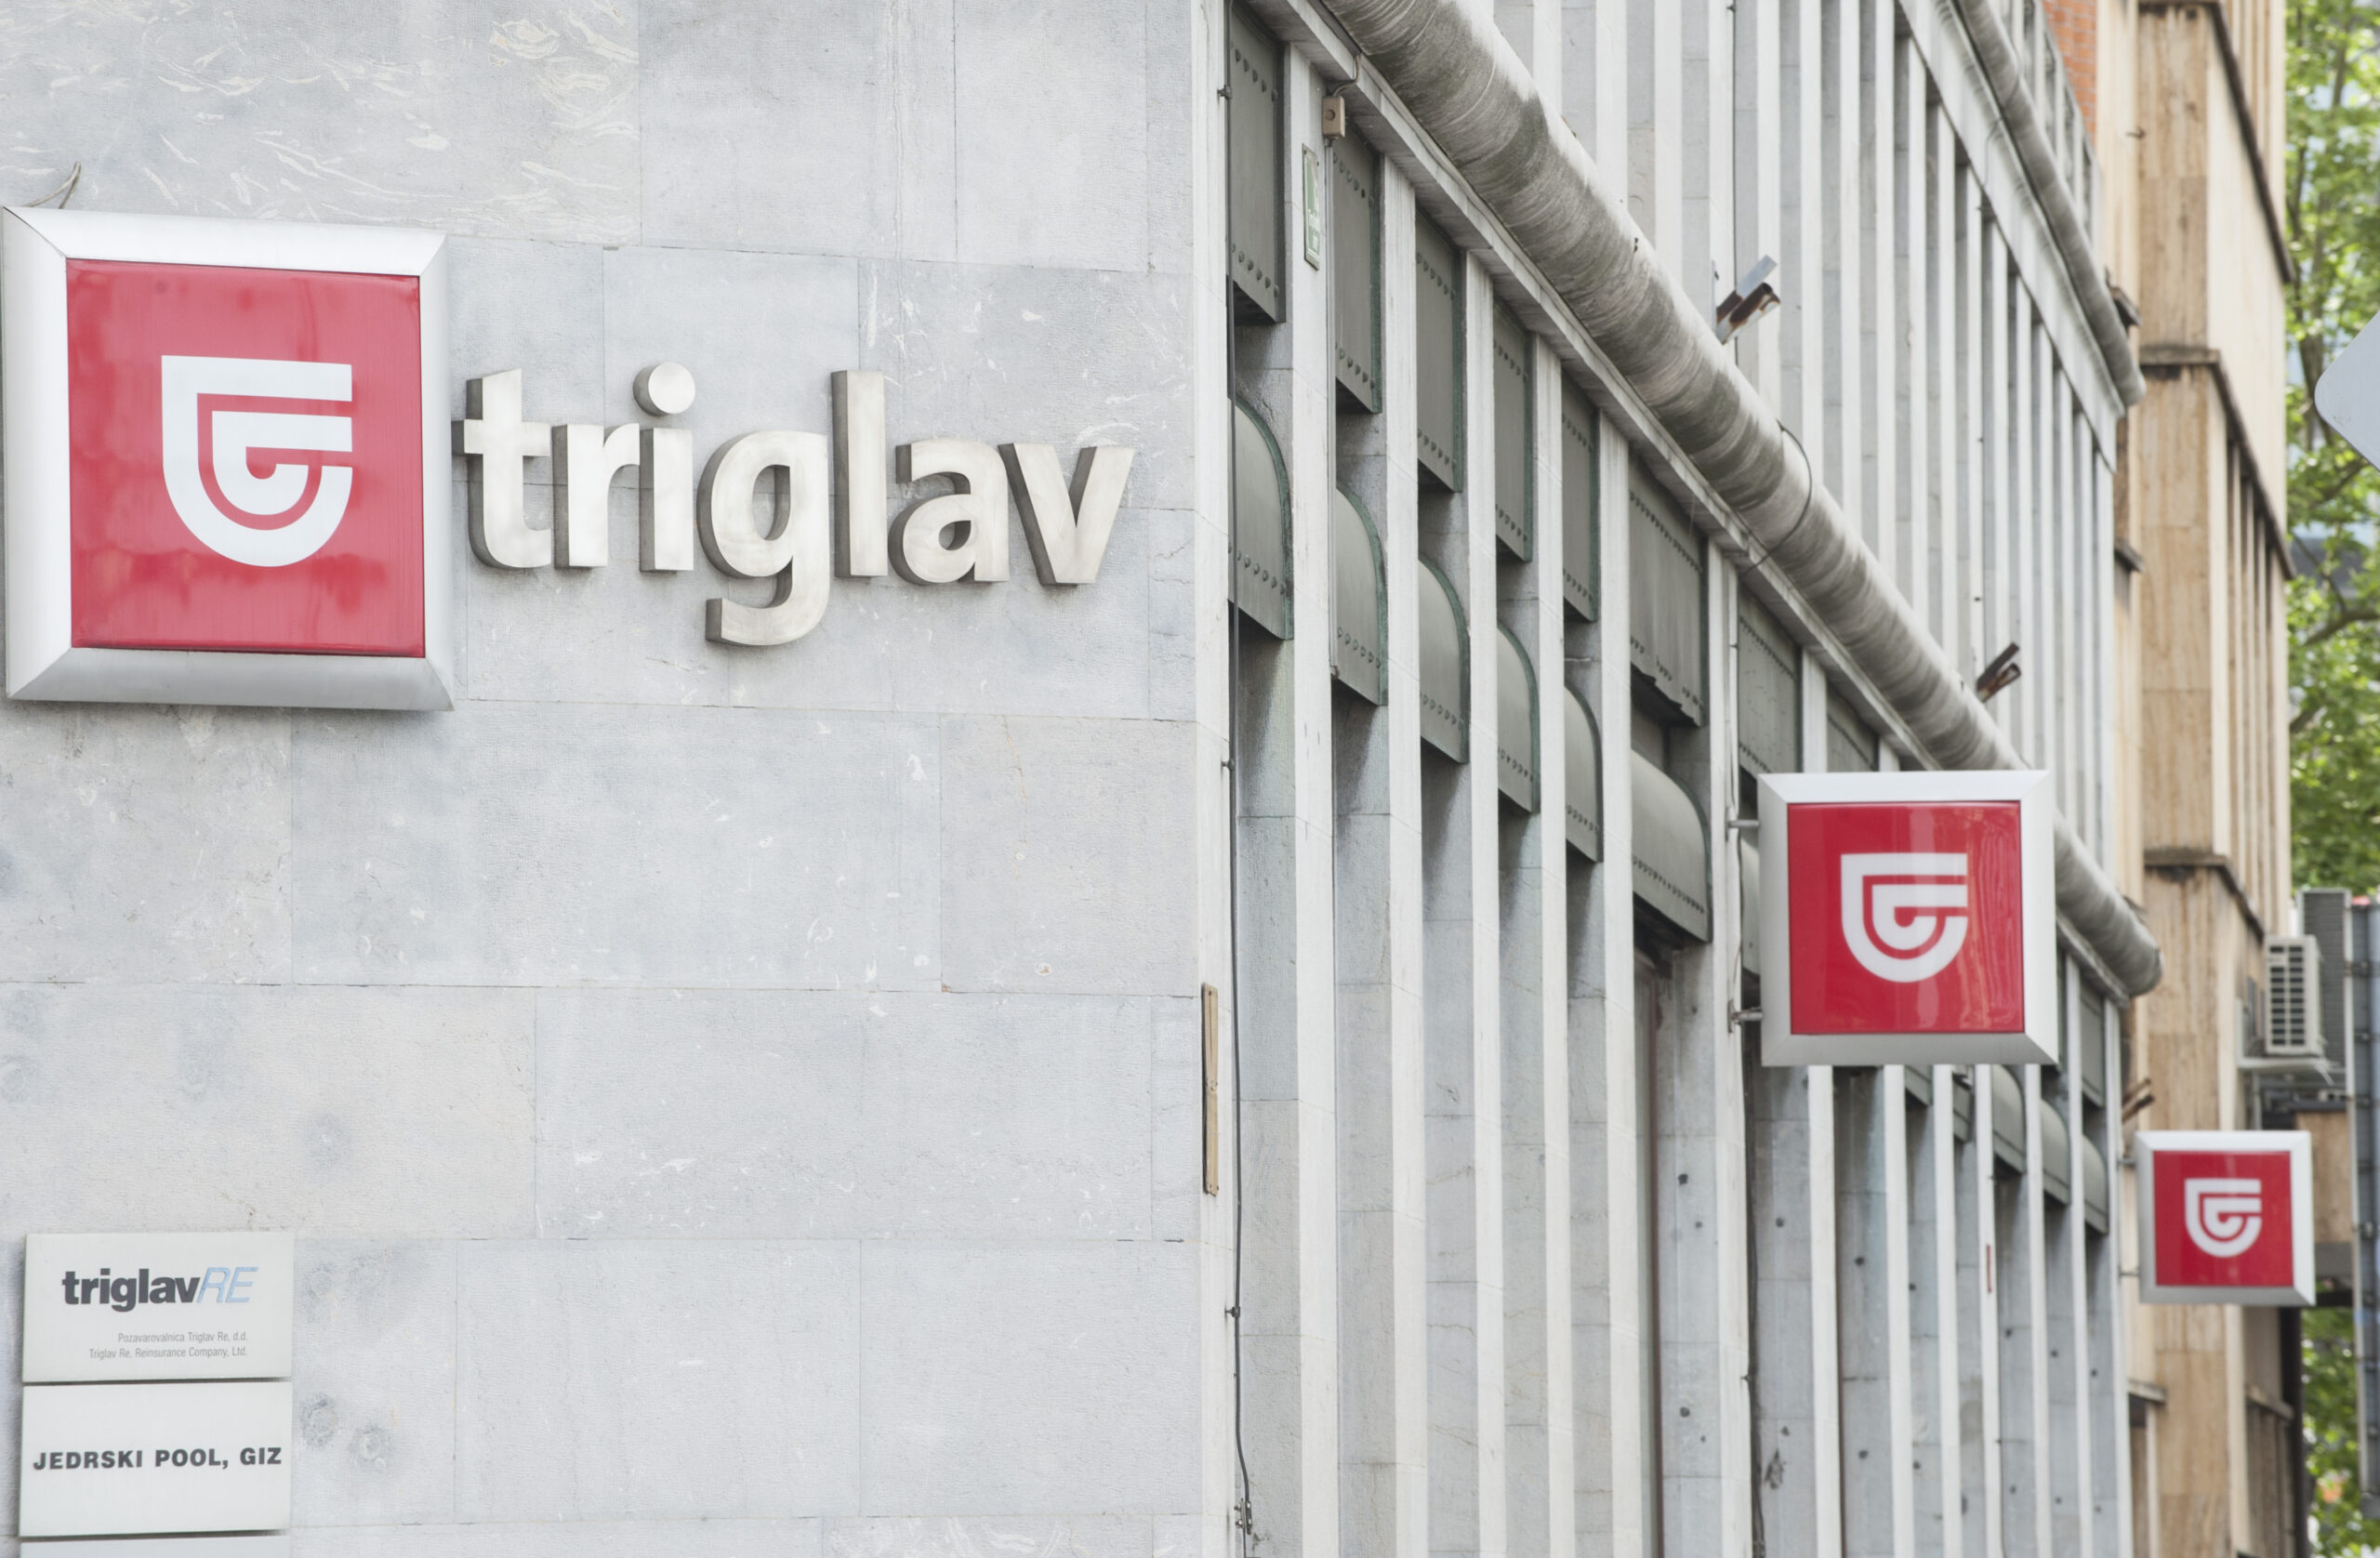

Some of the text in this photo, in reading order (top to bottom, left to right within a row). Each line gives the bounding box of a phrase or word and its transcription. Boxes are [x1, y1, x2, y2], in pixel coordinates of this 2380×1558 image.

[451, 362, 1135, 646] triglav
[118, 1332, 185, 1343] Pozavarovalnica
[188, 1330, 215, 1344] Triglav
[233, 1331, 248, 1341] d.d.
[89, 1348, 116, 1360] Triglav
[135, 1347, 186, 1358] Reinsurance
[189, 1346, 230, 1358] Company,
[231, 1346, 248, 1357] Ltd.
[33, 1446, 282, 1471] JEDRSKI POOL, GIZ
